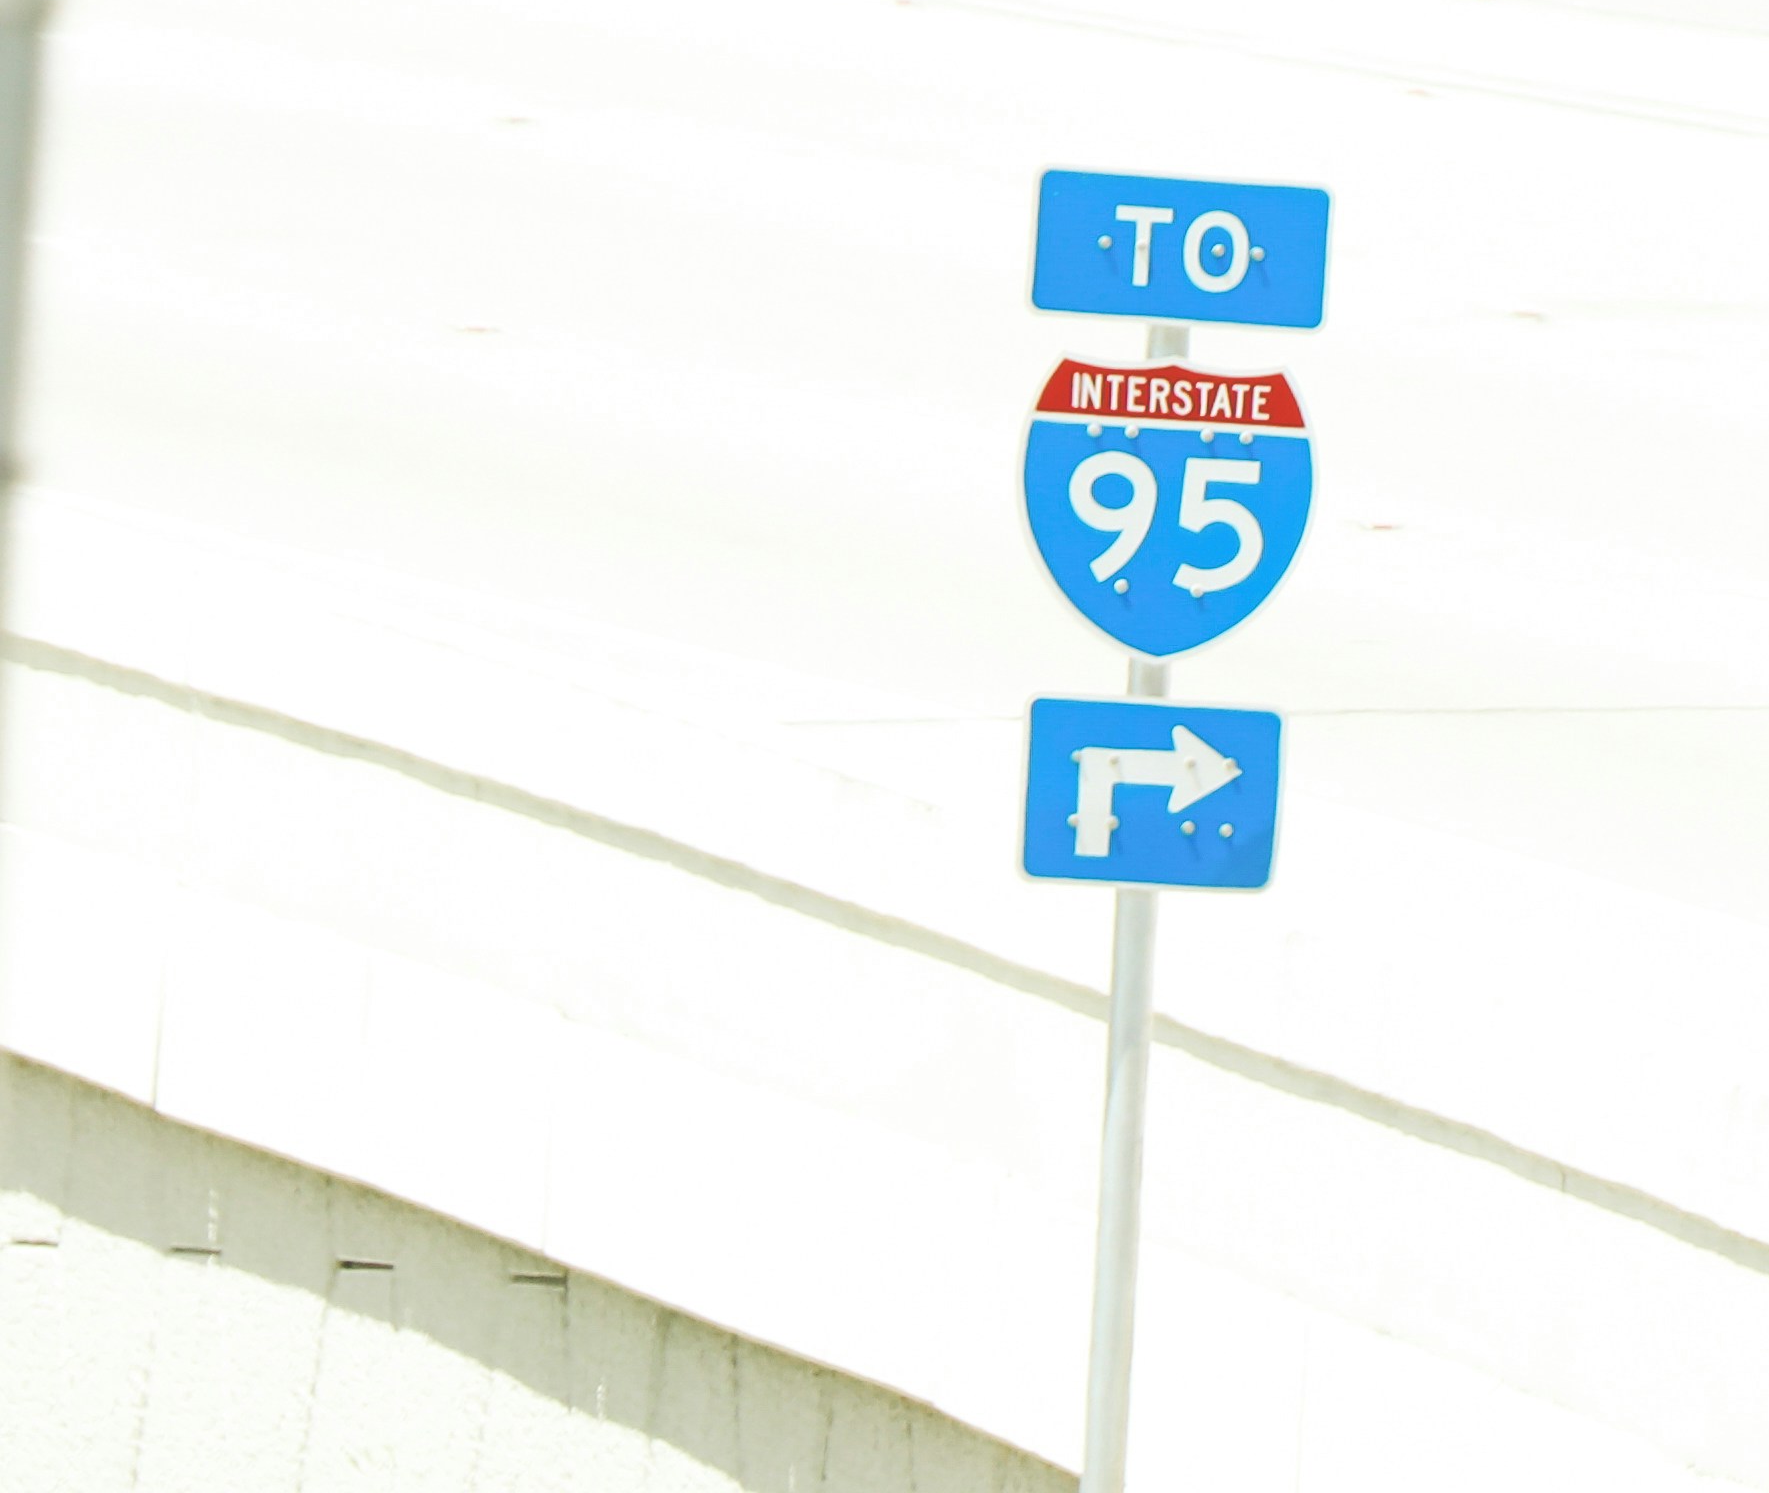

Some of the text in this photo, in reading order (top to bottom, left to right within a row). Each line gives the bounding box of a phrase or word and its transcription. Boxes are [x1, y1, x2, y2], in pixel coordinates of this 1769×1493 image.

[1115, 203, 1250, 293] TO
[1071, 371, 1272, 421] INTERSTATE
[1068, 450, 1264, 594] 95
